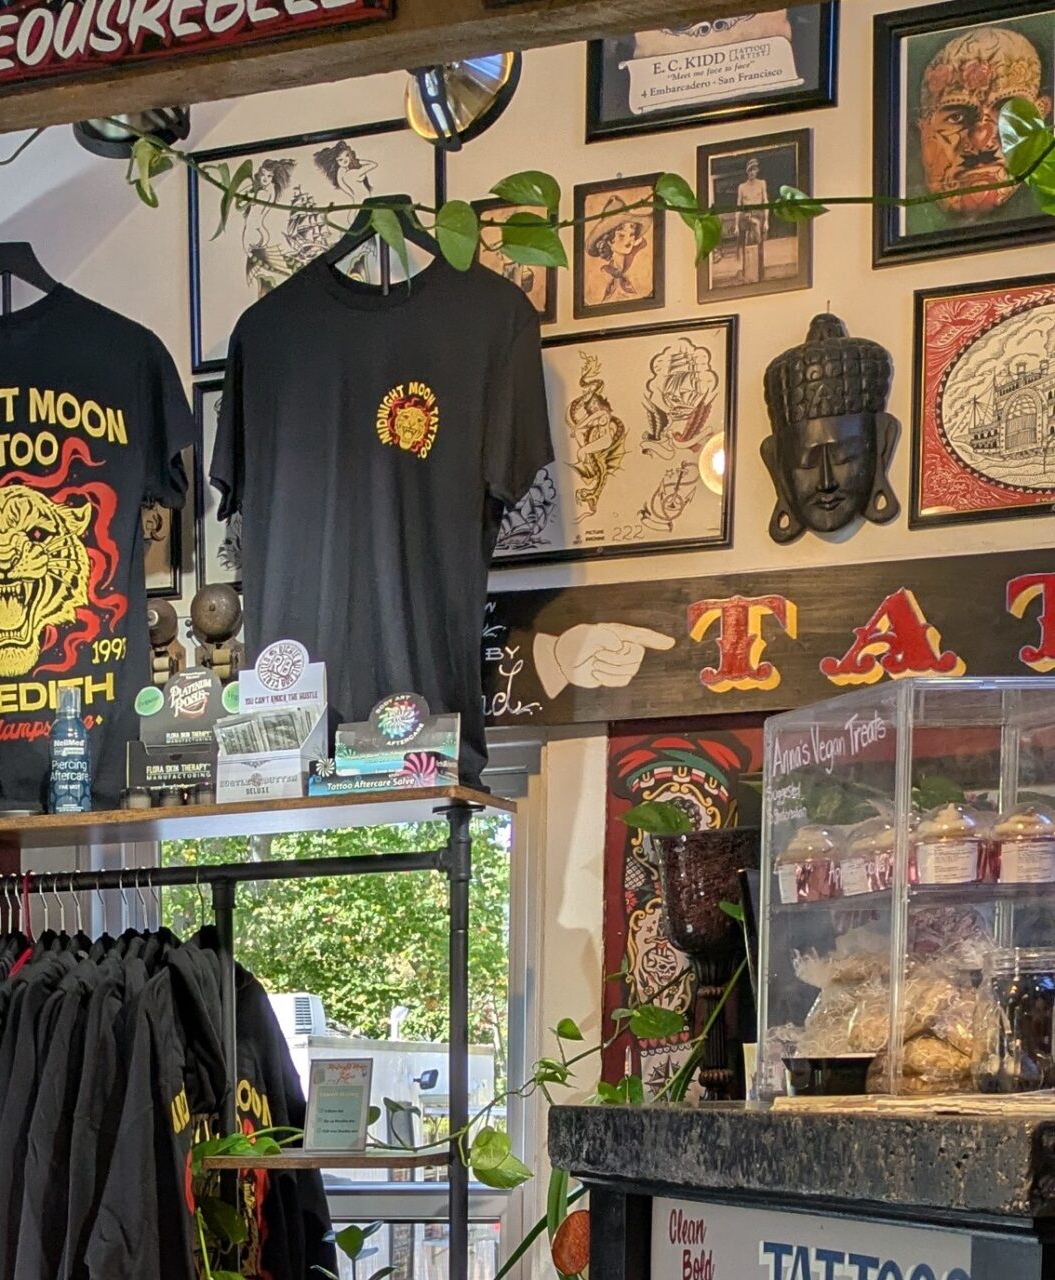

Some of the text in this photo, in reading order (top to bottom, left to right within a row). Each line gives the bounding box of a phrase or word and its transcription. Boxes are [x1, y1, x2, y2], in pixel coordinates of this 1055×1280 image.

[685, 52, 726, 70] KIDD
[732, 44, 768, 56] TATTOO
[733, 51, 767, 62] ARTIST
[706, 66, 723, 78] face
[725, 65, 732, 73] to
[650, 80, 711, 97] Embarcadero
[718, 75, 735, 86] San
[738, 69, 783, 83] Francisco
[28, 387, 128, 446] MOON
[377, 382, 439, 458] MIDNIGHT MOON TATTOO
[612, 525, 644, 542] 222
[170, 679, 212, 708] PLATINUM
[288, 693, 297, 701] THE
[386, 722, 424, 746] AFTERCARE
[772, 710, 886, 777] Anna's Vegan Treats
[51, 760, 87, 771] Piercing
[146, 765, 163, 774] FLORA
[165, 764, 179, 773] SKIN
[50, 771, 89, 781] Aftercare
[327, 777, 415, 791] Tattoo Aftercare Salve
[245, 787, 270, 795] DELUXE
[668, 1207, 707, 1246] Clean
